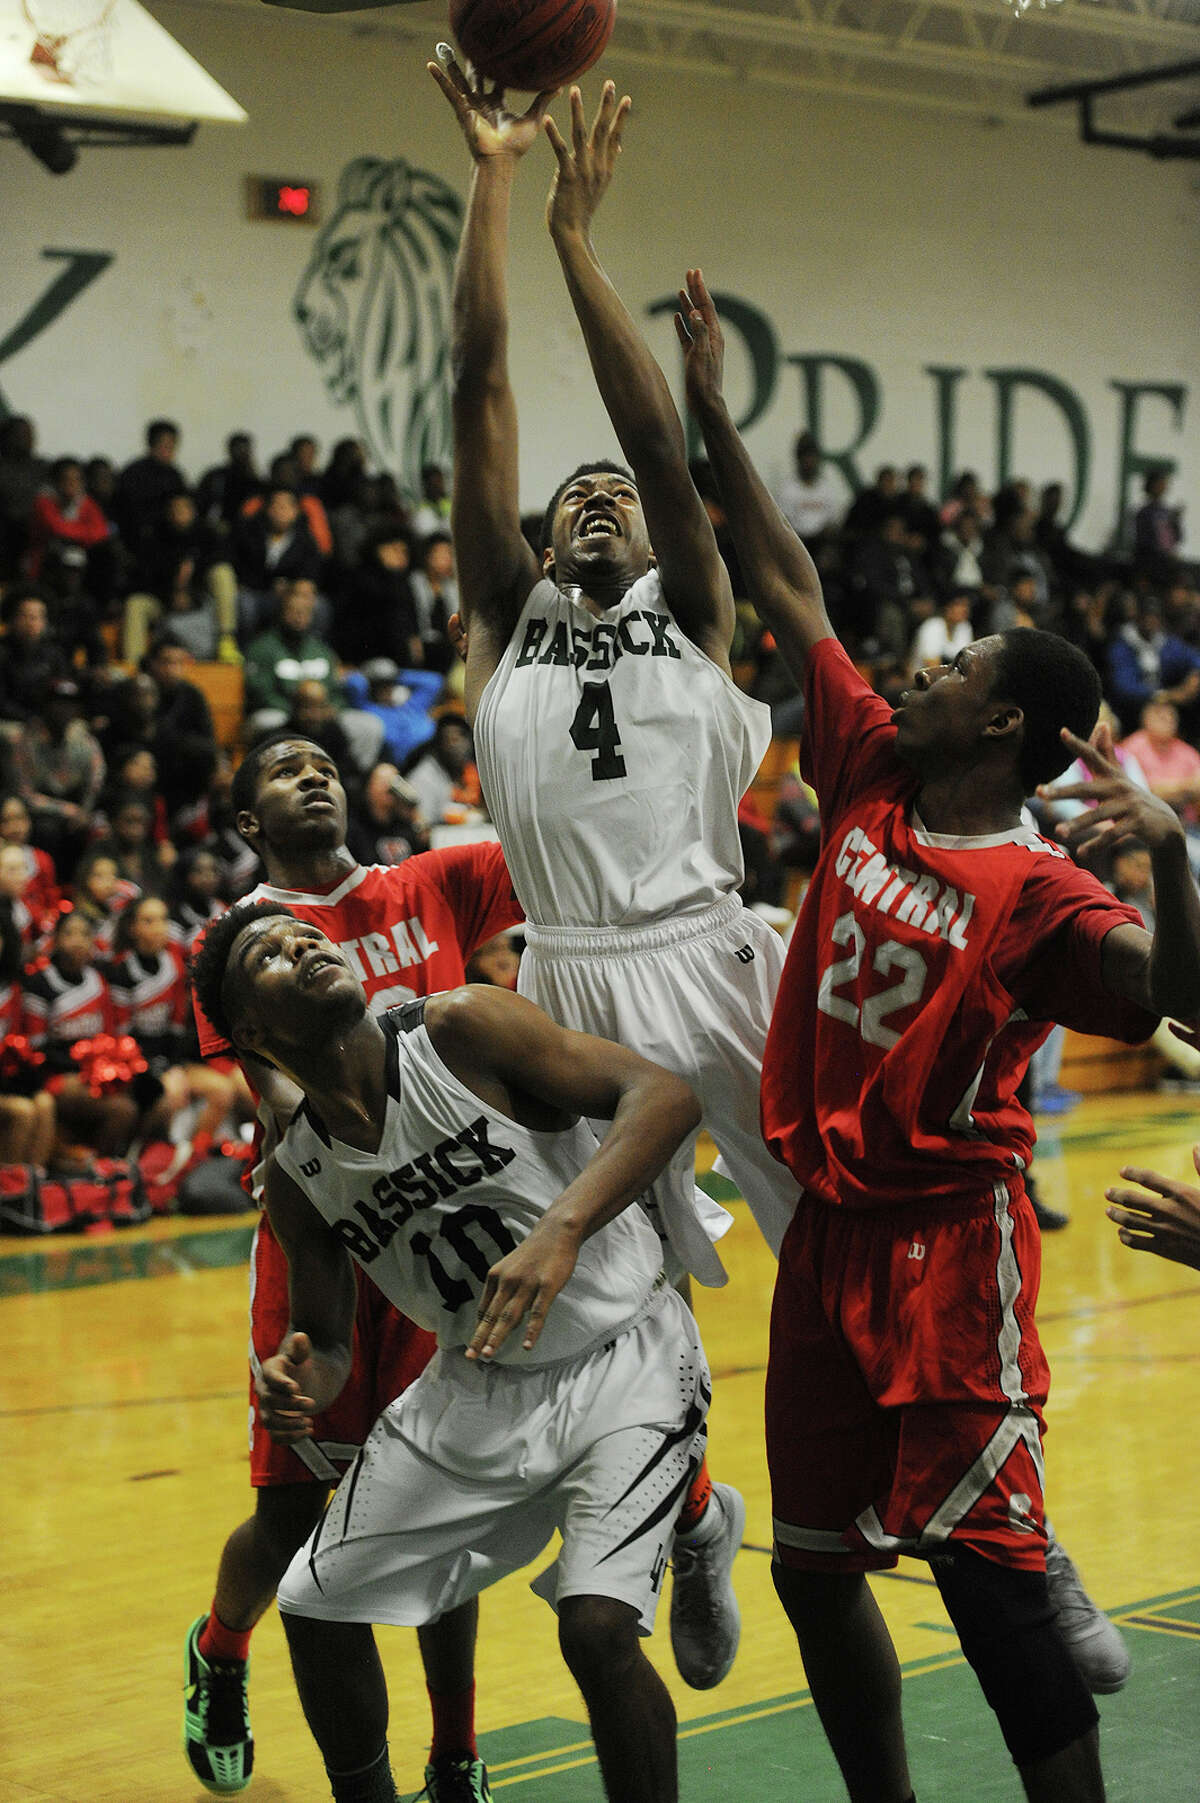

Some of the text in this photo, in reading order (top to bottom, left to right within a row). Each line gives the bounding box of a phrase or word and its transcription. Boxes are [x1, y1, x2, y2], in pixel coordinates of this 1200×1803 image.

[648, 291, 1188, 542] PRIDE
[569, 680, 627, 781] 4
[338, 916, 440, 983] TRAL
[835, 826, 976, 951] CENTRAL
[818, 910, 928, 1052] 22
[331, 1115, 517, 1264] BASSICK
[409, 1204, 519, 1314] 10
